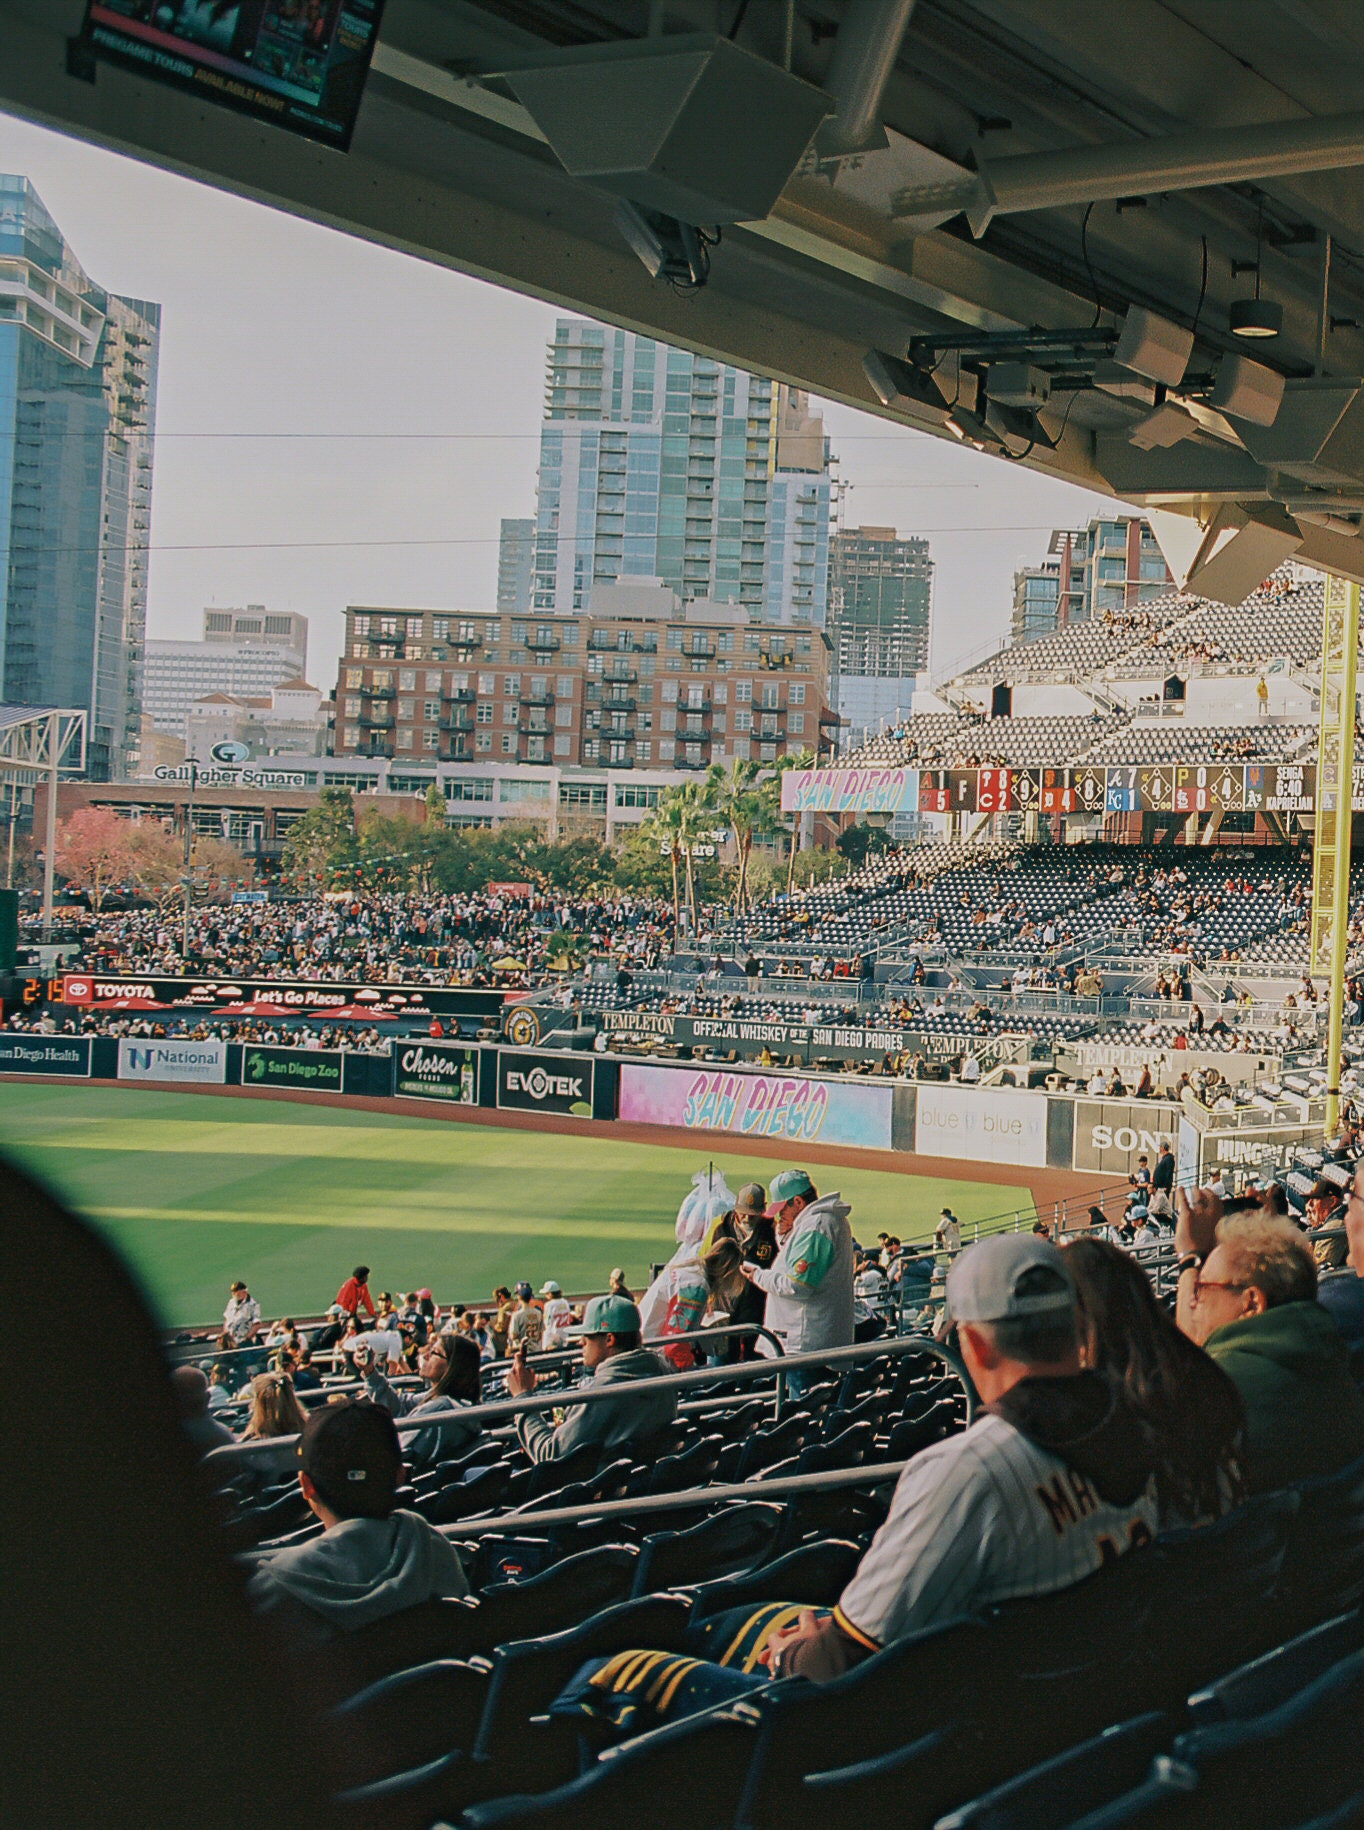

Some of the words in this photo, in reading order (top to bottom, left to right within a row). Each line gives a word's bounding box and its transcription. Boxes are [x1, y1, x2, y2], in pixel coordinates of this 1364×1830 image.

[242, 769, 303, 787] Square
[938, 770, 945, 789] 1
[998, 769, 1008, 789] 8
[1063, 768, 1070, 789] 1
[1127, 767, 1137, 788] 7
[1196, 767, 1207, 788] 0
[1276, 766, 1304, 780] SENGA
[793, 770, 838, 811] SAN
[838, 770, 905, 811] DIEGO
[958, 779, 967, 801] F
[1020, 778, 1030, 801] 9
[1084, 778, 1094, 801] 8
[1151, 778, 1161, 800] 4
[1221, 777, 1231, 800] 4
[1275, 779, 1303, 797] 6:40
[937, 790, 945, 811] 5
[998, 790, 1007, 810] 2
[1061, 789, 1071, 811] 4
[1128, 789, 1135, 811] 1
[1196, 789, 1206, 811] 0
[1266, 796, 1313, 811] KAPRIELIAN
[23, 978, 65, 1003] 2:15
[94, 984, 156, 999] TOYOTA
[253, 989, 284, 1004] Let's
[284, 991, 304, 1005] Go
[306, 992, 346, 1006] Places
[602, 1012, 676, 1036] TEMPLETON
[693, 1020, 739, 1039] OFFICIAL
[739, 1022, 788, 1043] WHISKEY
[812, 1028, 833, 1046] SAN
[834, 1030, 863, 1048] DIEGO
[864, 1032, 904, 1051] PADRES
[14, 1046, 44, 1063] Diego
[45, 1047, 80, 1062] Health
[157, 1049, 219, 1065] National
[401, 1046, 459, 1076] Chosen
[268, 1060, 288, 1074] San
[288, 1061, 318, 1079] Diego
[318, 1064, 339, 1078] Zoo
[506, 1066, 583, 1100] EVOTEK
[683, 1070, 744, 1130] SAN
[741, 1076, 830, 1141] DIEGO
[920, 1104, 959, 1129] blue
[983, 1111, 1023, 1136] blue
